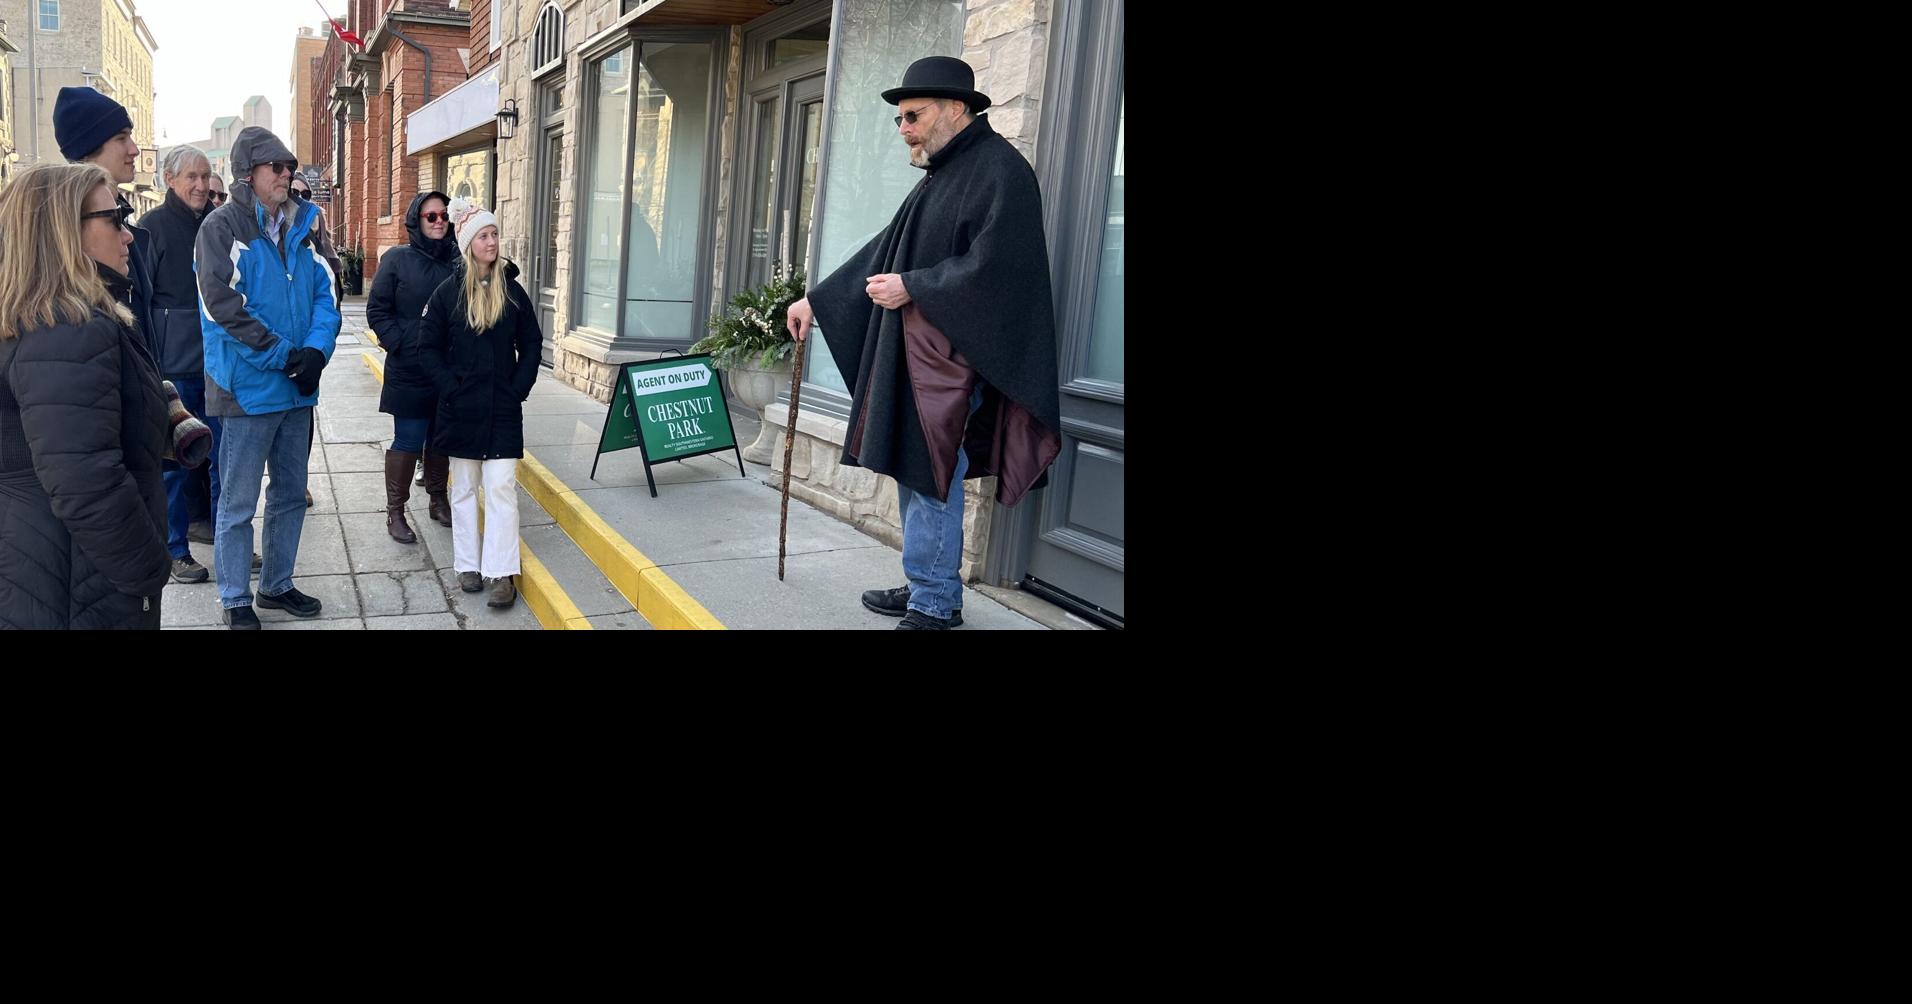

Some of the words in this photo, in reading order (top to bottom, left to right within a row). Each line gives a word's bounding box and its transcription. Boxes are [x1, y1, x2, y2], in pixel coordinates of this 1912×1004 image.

[638, 376, 665, 389] AGENT
[668, 374, 681, 384] ON
[683, 370, 705, 382] DUTY
[647, 397, 713, 422] CHESTNUT
